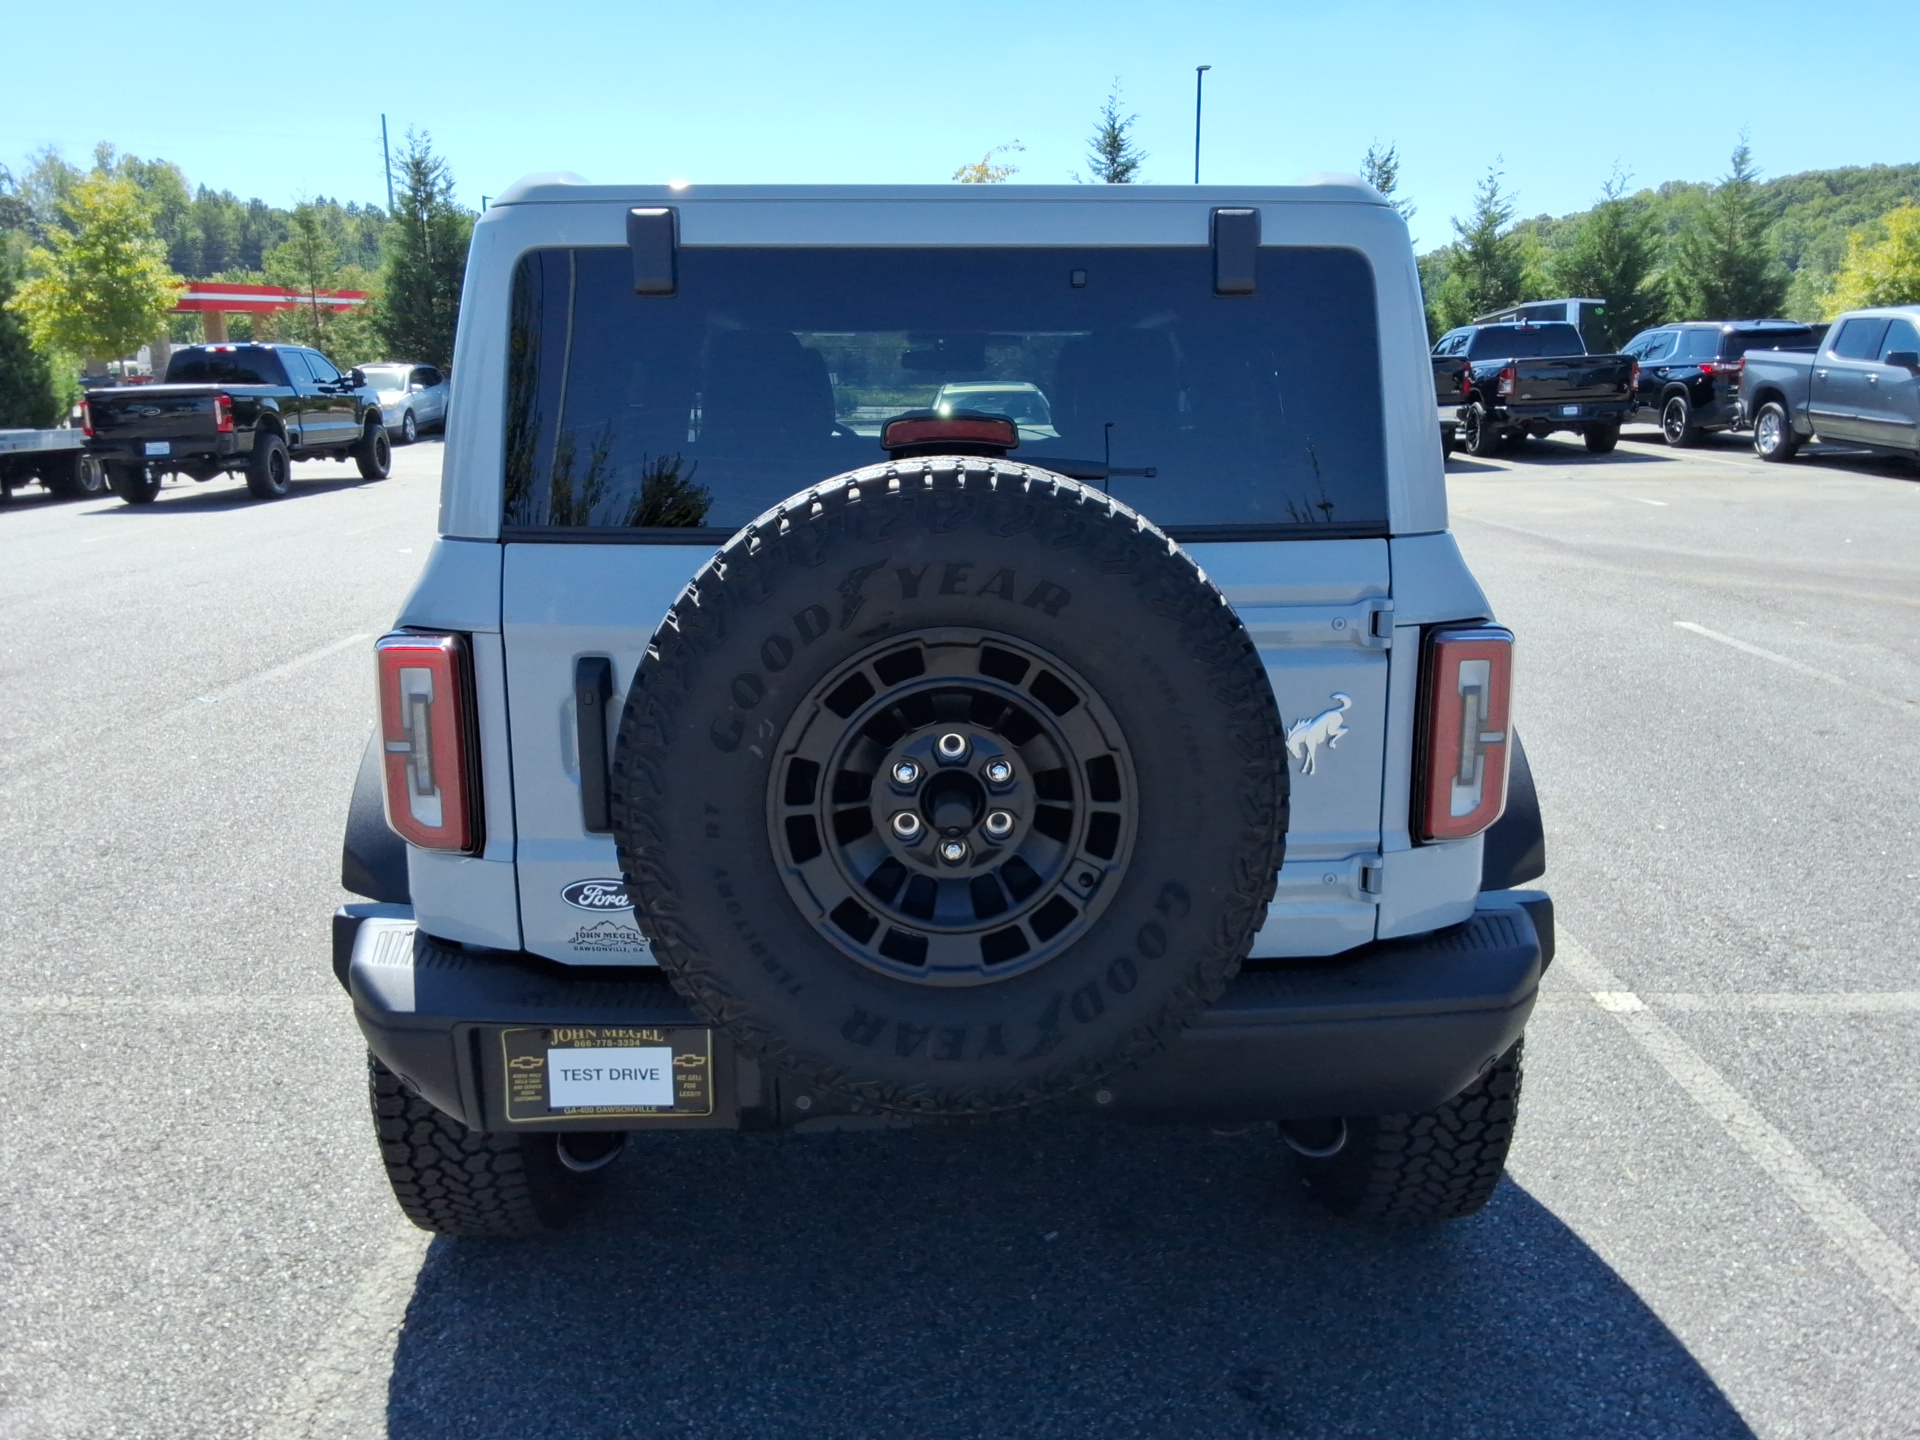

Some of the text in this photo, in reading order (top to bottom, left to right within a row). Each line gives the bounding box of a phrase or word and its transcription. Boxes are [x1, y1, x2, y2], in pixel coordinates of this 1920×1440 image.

[575, 931, 639, 941] JOHN MEGEL
[550, 1028, 664, 1046] JOHN MEGEL
[560, 1068, 660, 1081] TEST DRIVE
[596, 1105, 658, 1114] DAWSONVILLE
